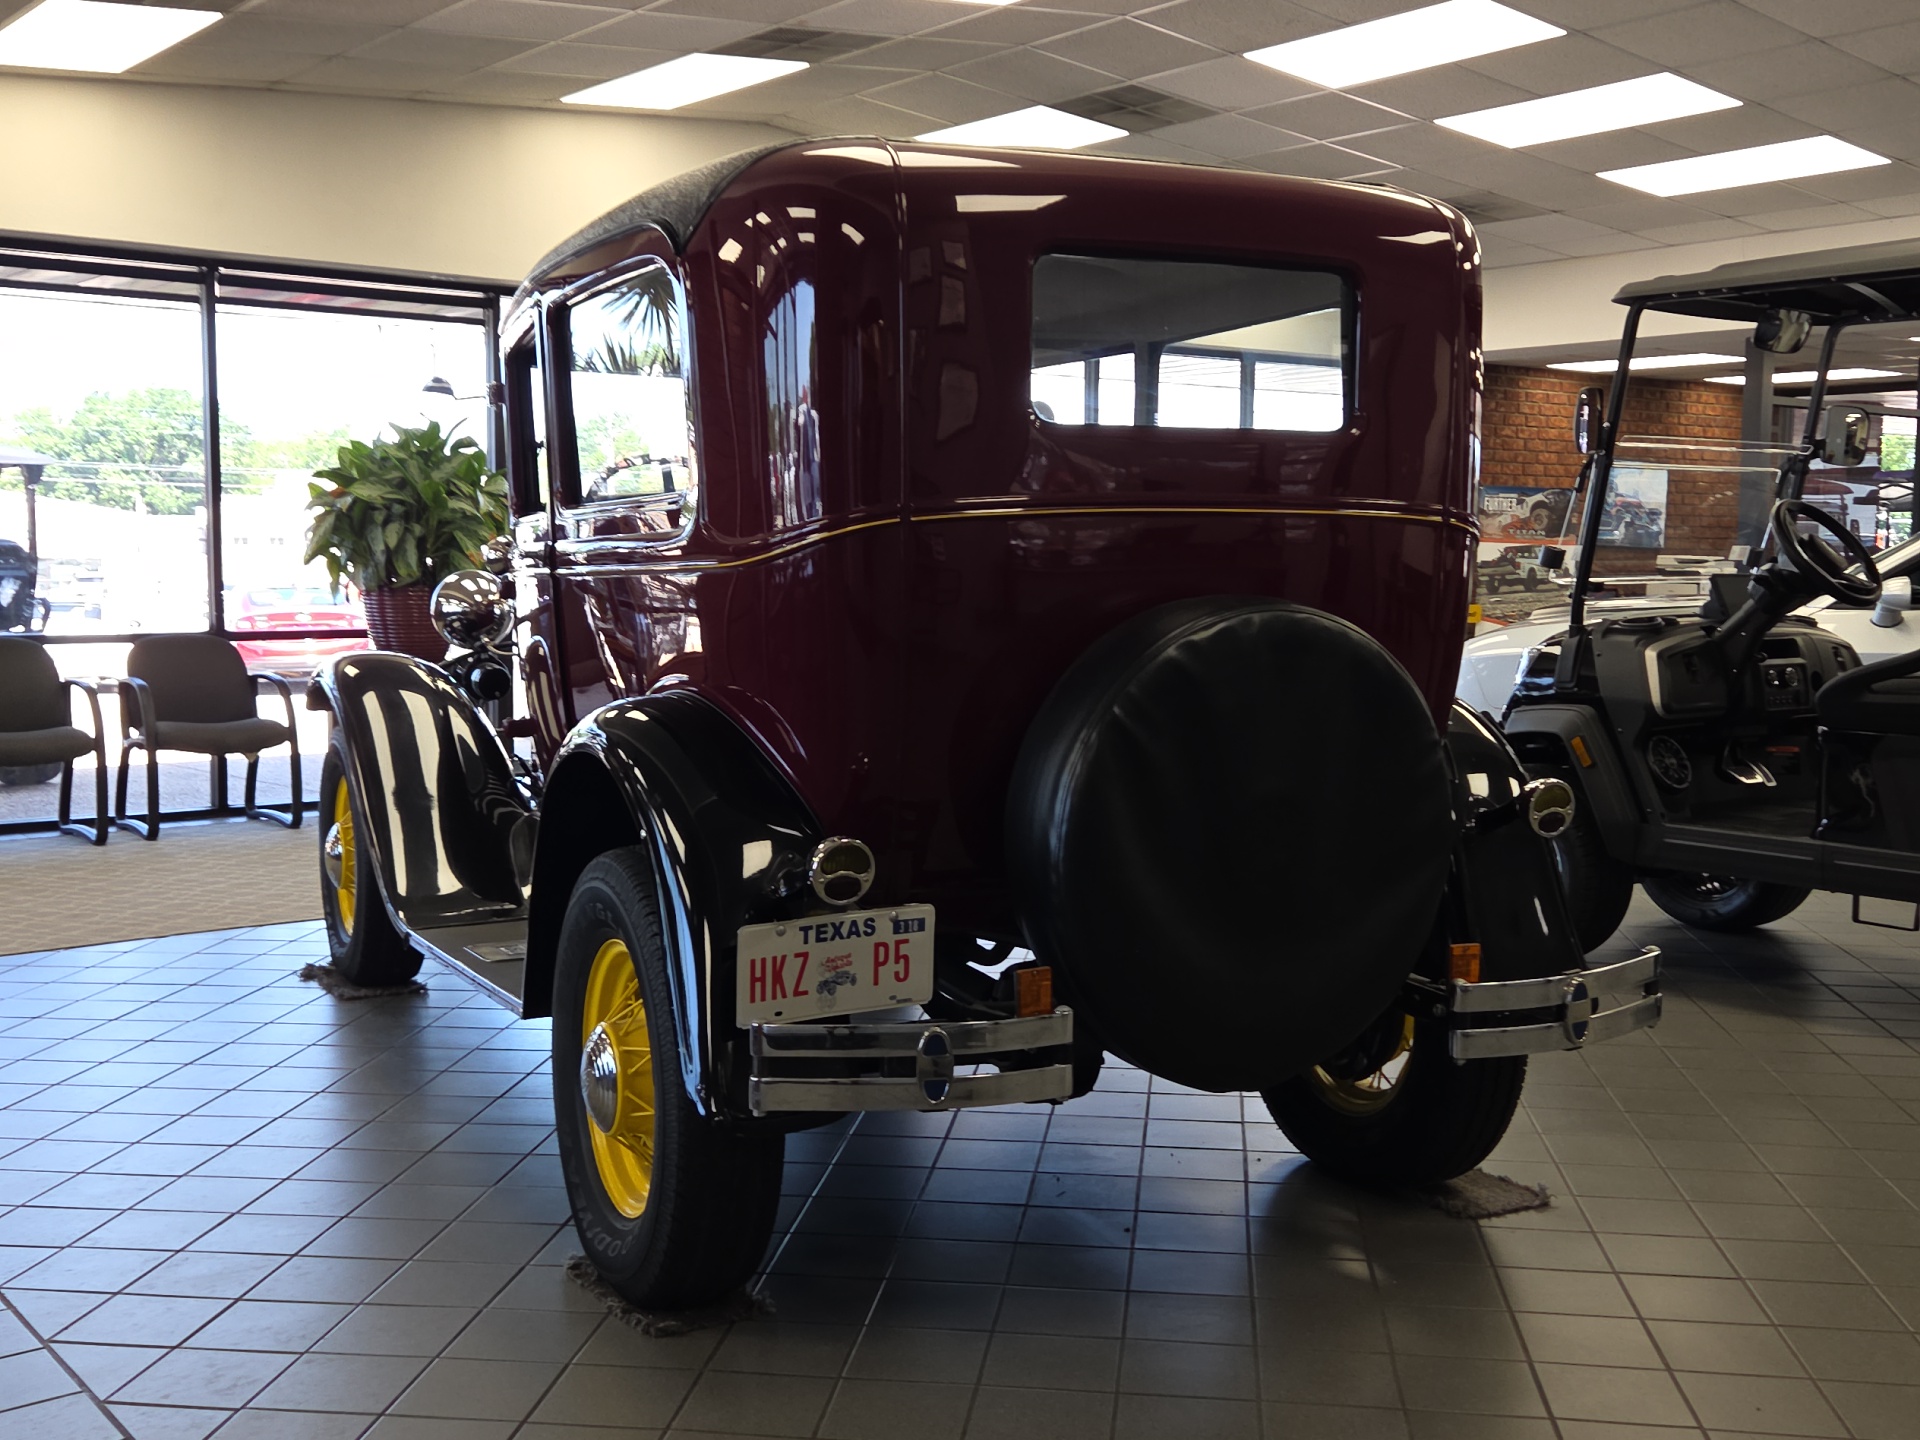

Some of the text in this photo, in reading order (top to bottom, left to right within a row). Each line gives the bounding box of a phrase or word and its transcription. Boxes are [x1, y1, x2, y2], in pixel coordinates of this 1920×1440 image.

[1508, 528, 1546, 536] TITAN
[799, 917, 876, 945] TEXAS
[749, 938, 911, 1004] HKZ P5
